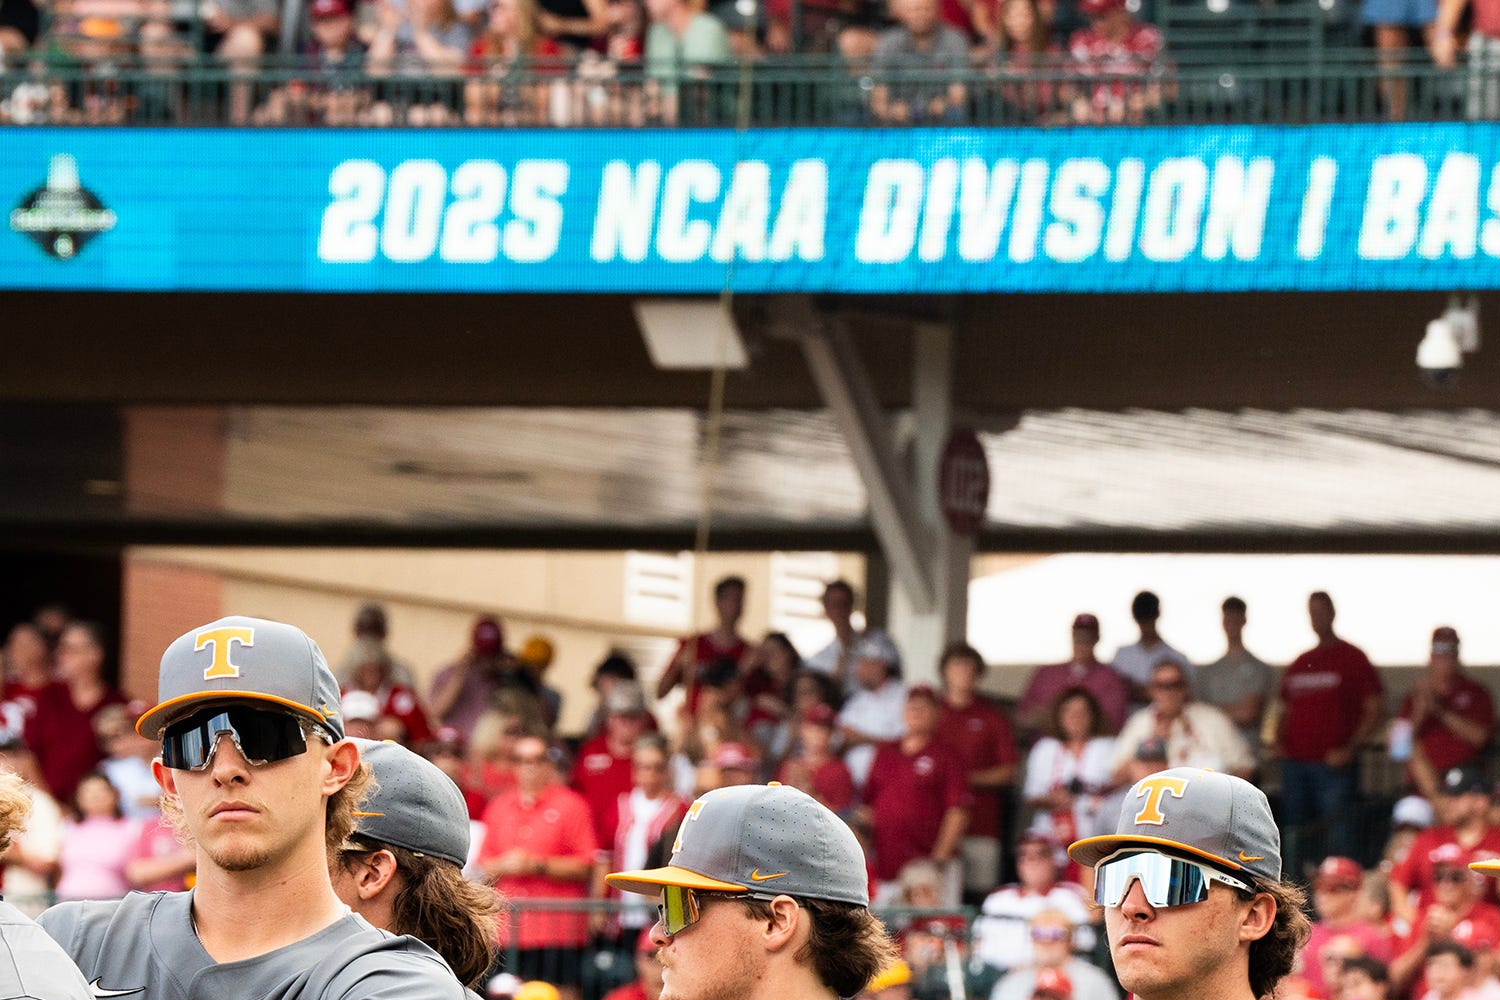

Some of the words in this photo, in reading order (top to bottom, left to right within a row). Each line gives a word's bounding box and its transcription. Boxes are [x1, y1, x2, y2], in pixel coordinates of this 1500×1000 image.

[317, 158, 570, 263] 2025
[590, 158, 828, 263] NCAA
[855, 156, 1274, 264] DIVISION
[1296, 154, 1338, 262] I
[194, 627, 255, 680] T
[1134, 777, 1190, 825] T
